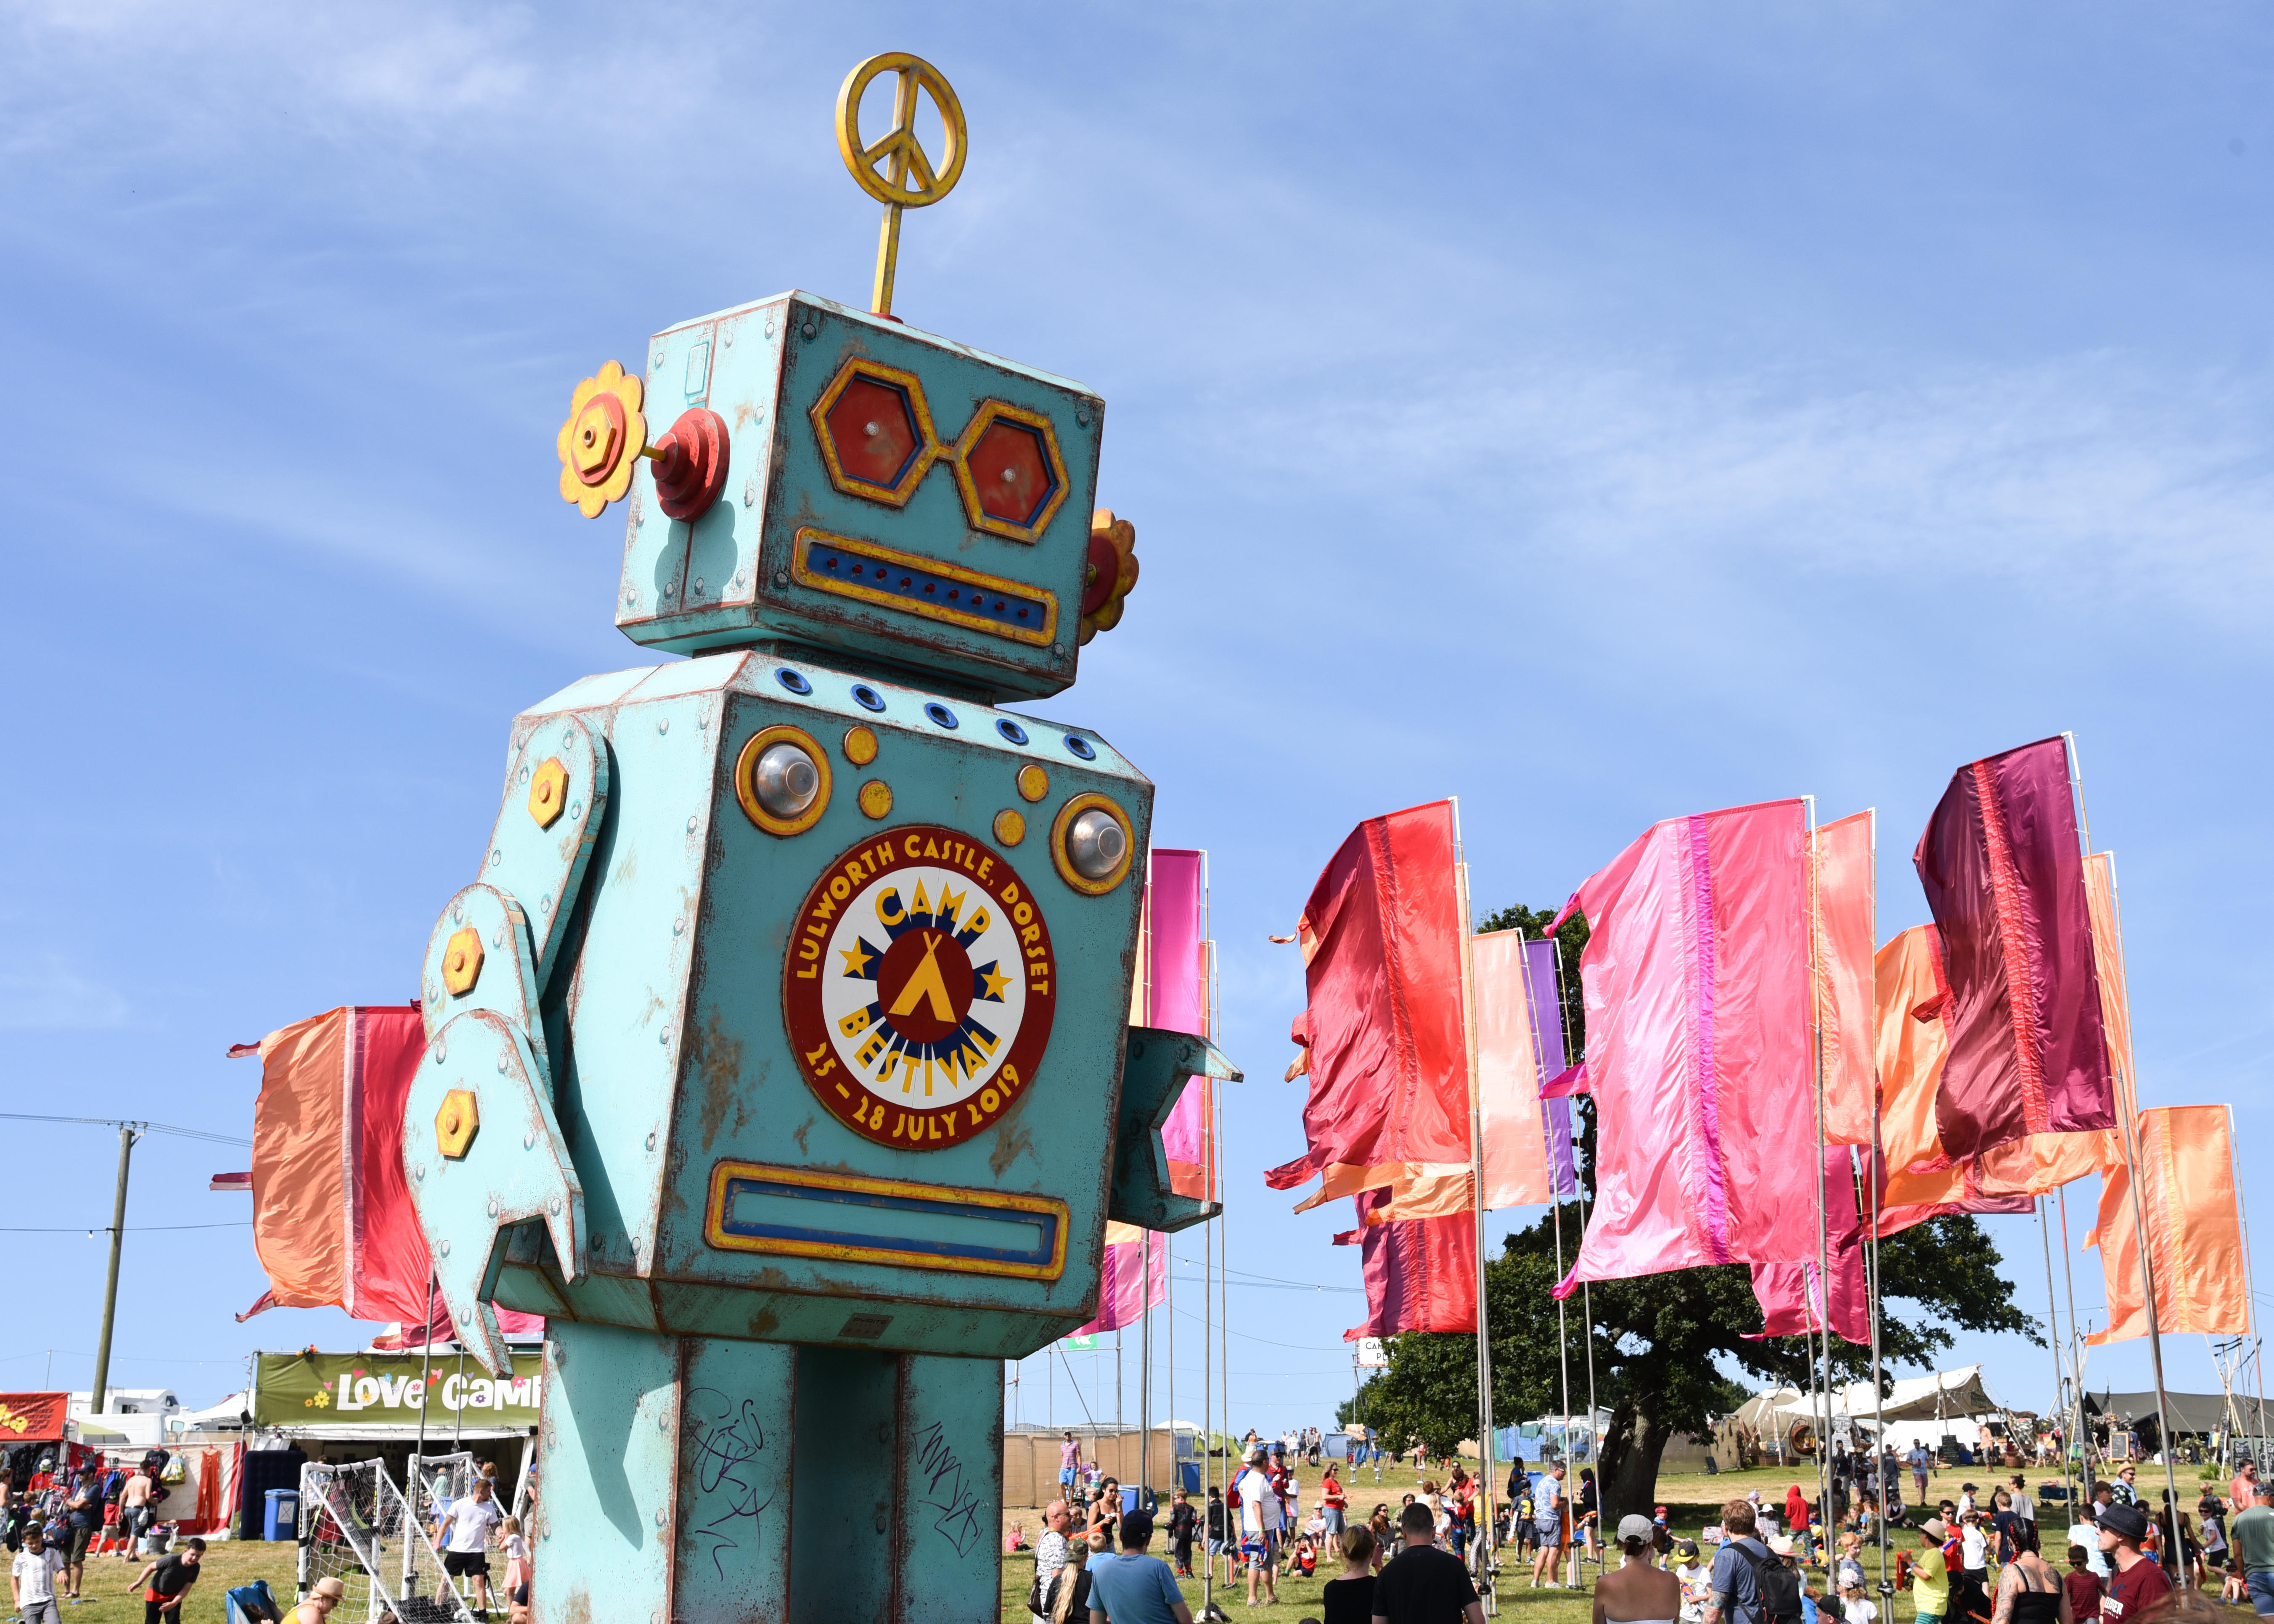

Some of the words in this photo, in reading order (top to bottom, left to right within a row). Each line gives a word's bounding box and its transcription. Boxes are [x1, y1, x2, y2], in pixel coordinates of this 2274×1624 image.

[797, 841, 895, 979] LULWORTH
[904, 834, 995, 886] CASTLE,
[1000, 882, 1048, 995] DORSET
[875, 876, 991, 934] CAMP
[805, 1042, 837, 1077] 25
[852, 1095, 885, 1131] 28
[892, 1111, 957, 1141] JULY
[970, 1063, 1020, 1124] 2019
[837, 1005, 1002, 1096] BESTIVAL
[2104, 1596, 2124, 1615] LLISTER
